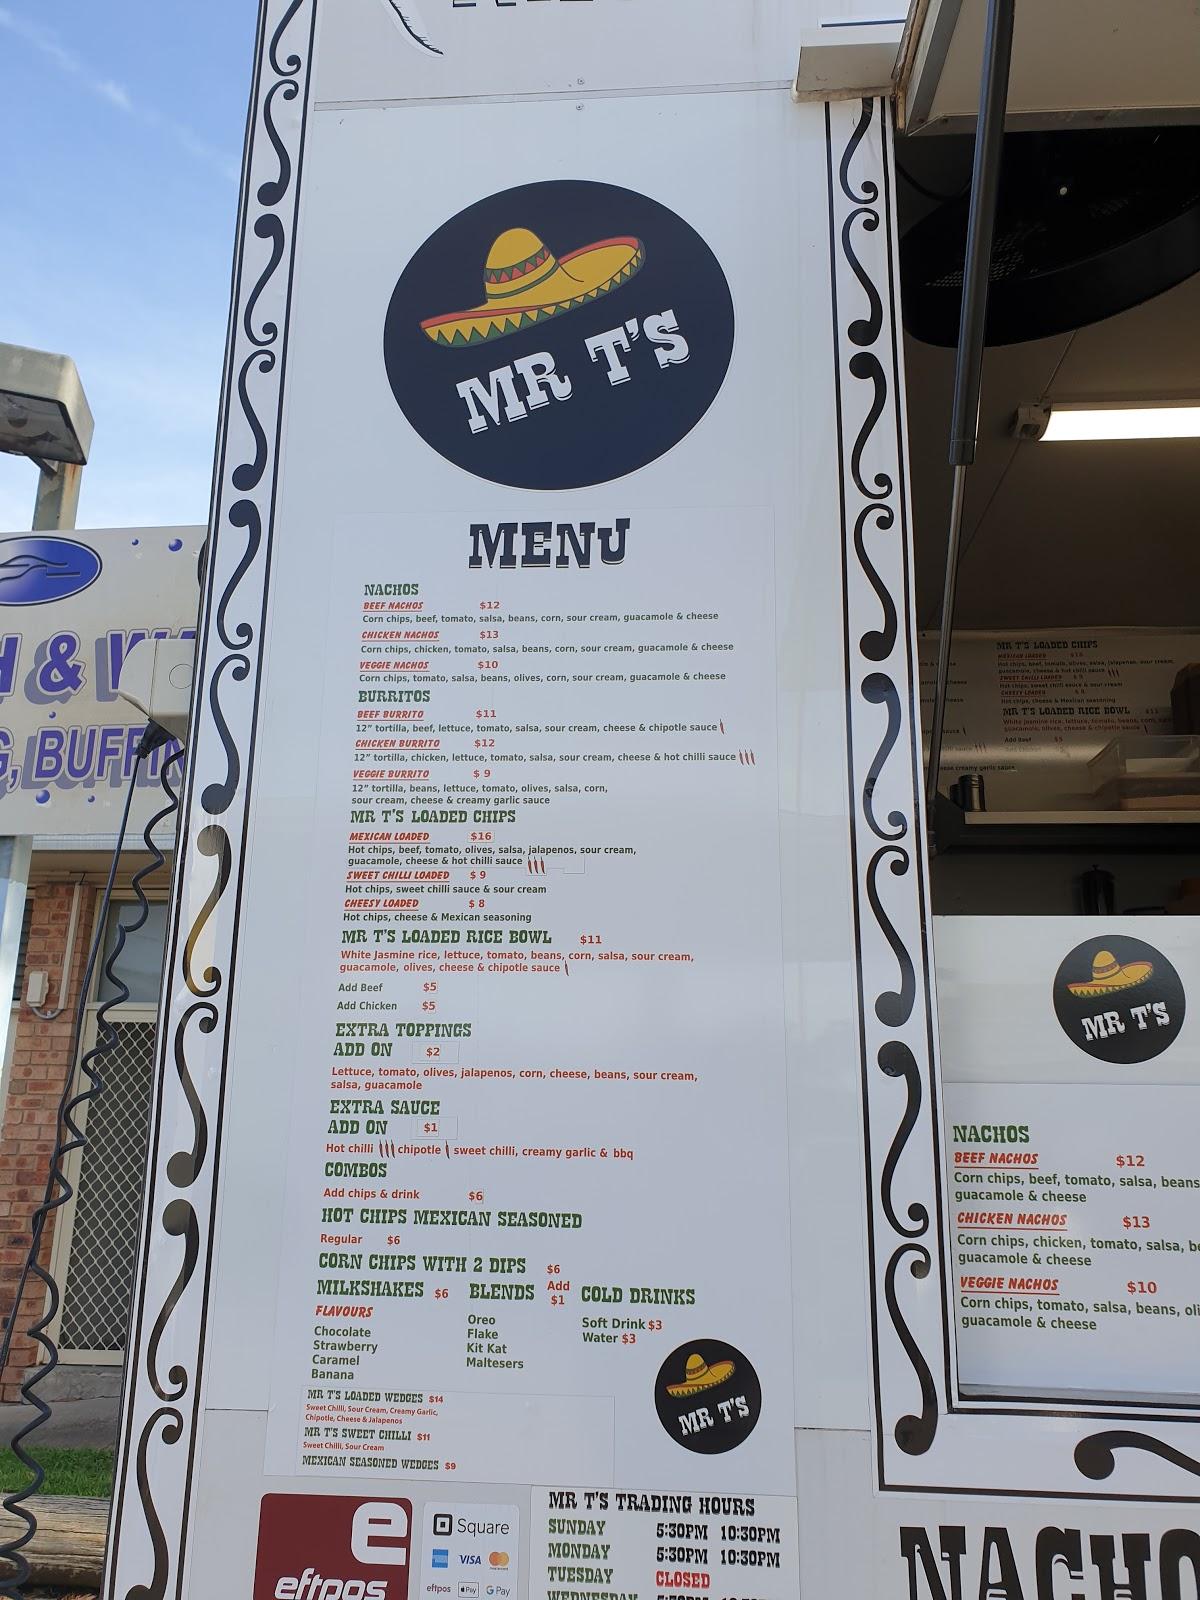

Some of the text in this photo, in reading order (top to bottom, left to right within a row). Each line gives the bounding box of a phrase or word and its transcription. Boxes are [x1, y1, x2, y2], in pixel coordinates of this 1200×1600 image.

[469, 518, 630, 569] MENU
[364, 584, 418, 596] NACHOS
[364, 602, 499, 612] BEEF NACHOS $12
[362, 630, 498, 640] CHICKEN NACHOS $13
[361, 644, 382, 656] Corn
[384, 644, 412, 656] chips,
[414, 644, 451, 655] chicken,
[454, 646, 490, 654] tomato,
[492, 645, 518, 655] salsa,
[522, 645, 552, 654] beans,
[638, 643, 688, 653] guacamole
[38, 632, 86, 695] &
[360, 661, 498, 671] VEGGIE NACHOS $10
[358, 690, 430, 702] BURRITOS
[358, 710, 496, 720] BEEF BURRITO $11
[354, 770, 429, 780] VEGGIE BURRITO
[351, 810, 515, 823] MR T'S LOADED CHIPS
[345, 899, 419, 907] CHEESY LOADED
[344, 913, 531, 923] Hot chips, cheese & Mexican seasoning
[342, 930, 602, 945] MR T'S LOADED RICE BOWL $11
[338, 982, 436, 993] Add Beef $5
[337, 1000, 435, 1011] Add Chicken $5
[336, 1023, 471, 1037] EXTRA TOPPINGS
[334, 1042, 440, 1058] ADD ON $2
[330, 1100, 440, 1115] EXTRA SAUCE
[328, 1120, 437, 1135] ADD ON $1
[953, 1125, 1029, 1143] NACHOS
[327, 1143, 441, 1156] Hot chilli chipotle
[325, 1162, 387, 1177] COMBOS
[324, 1188, 483, 1202] Add chips & drink $6
[322, 1208, 582, 1228] HOT CHIPS MEXICAN SEASONED
[958, 1213, 1150, 1230] CHICKEN NACHOS $13
[321, 1234, 400, 1246] Regular $6
[319, 1253, 560, 1276] CORN CHIPS WITH 2 DIPS $6
[317, 1280, 448, 1300] MILKSHAKES $6
[470, 1284, 534, 1300] BLENDS
[548, 1281, 570, 1290] Add
[551, 1294, 564, 1306] $1
[582, 1286, 695, 1305] COLD DRINKS
[316, 1306, 373, 1318] FLAVOURS
[468, 1314, 495, 1325] Oreo
[582, 1317, 662, 1331] Soft Drink $3
[315, 1326, 371, 1337] Chocolate
[468, 1328, 498, 1339] Flake
[583, 1332, 636, 1344] Water $3
[313, 1340, 378, 1354] Strawberry
[467, 1343, 507, 1354] Kit Kat
[312, 1355, 359, 1365] Caramel
[467, 1358, 523, 1368] Maltesers
[312, 1370, 354, 1380] Banana
[308, 1390, 323, 1399] MR
[327, 1390, 341, 1400] T'S
[344, 1391, 380, 1401] LOADED
[385, 1393, 423, 1403] WEDGES
[678, 1395, 750, 1436] MR T'S
[305, 1427, 320, 1436] MR
[324, 1428, 338, 1438] T'S
[342, 1428, 375, 1440] SWEET
[379, 1430, 411, 1440] CHILLI
[303, 1456, 456, 1470] MEXICAN SEASONED WEDGES $9
[549, 1492, 754, 1516] MR T'S TRADING HOURS
[458, 1518, 509, 1537] Square
[549, 1518, 780, 1544] SUNDAY 5:30PM 10:30PM
[460, 1555, 481, 1564] VISA
[548, 1542, 780, 1568] MONDAY 5:30PM 10:30PM
[548, 1566, 710, 1588] TUESDAY CLOSED
[274, 1568, 388, 1600] eftpos
[427, 1584, 451, 1594] eftpos
